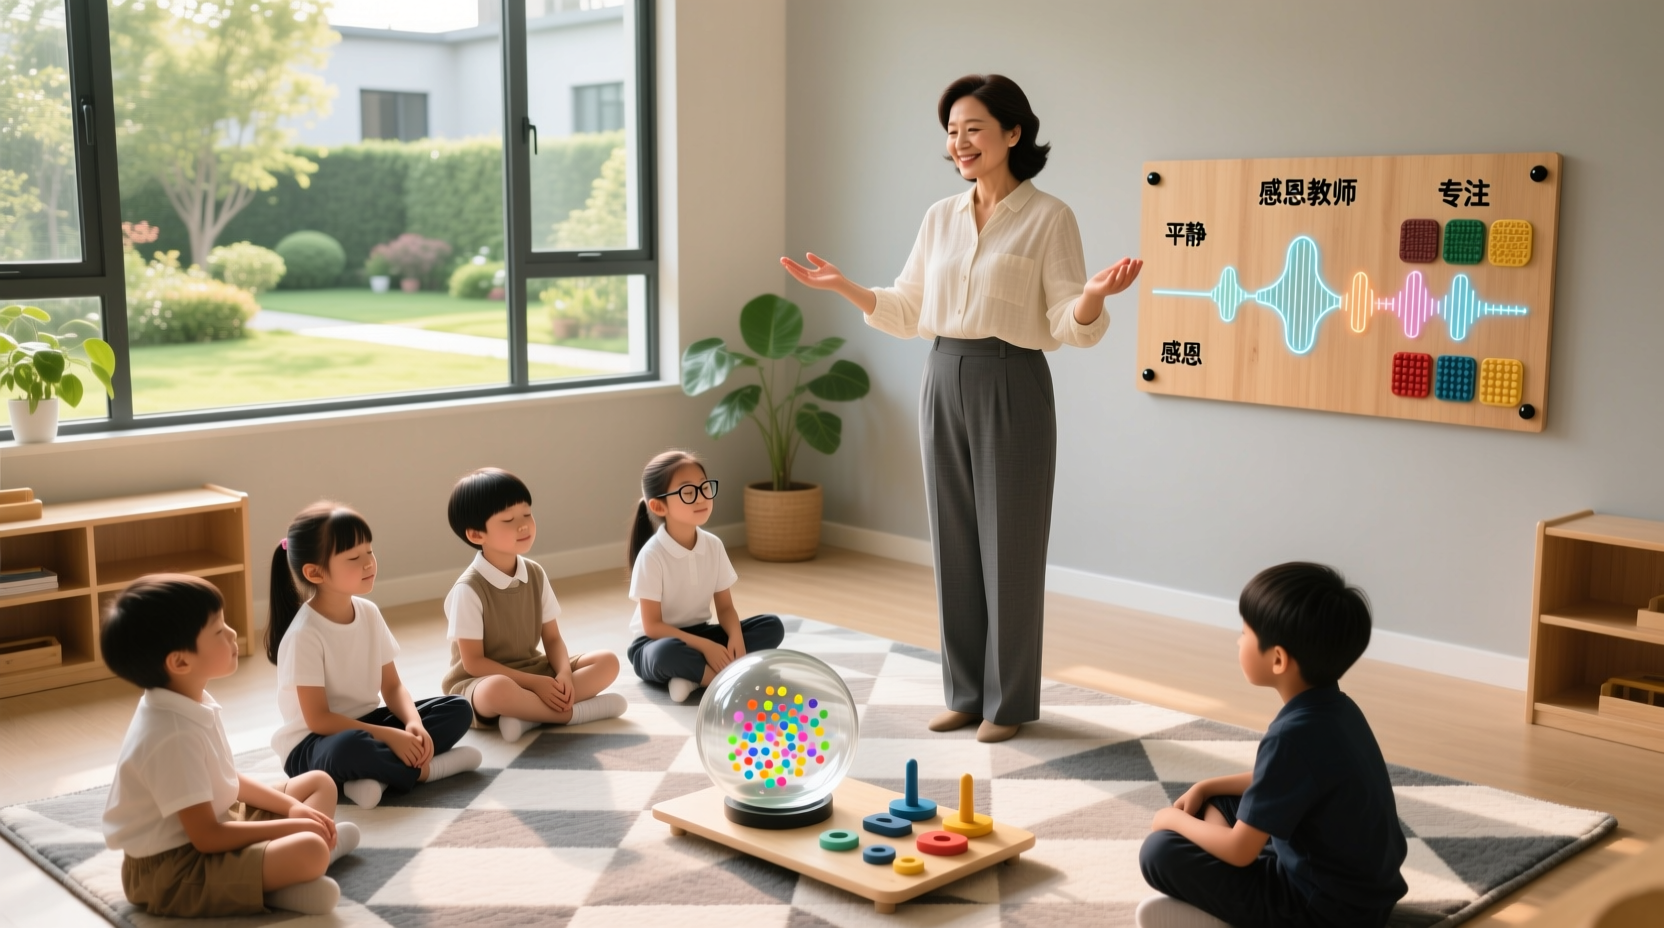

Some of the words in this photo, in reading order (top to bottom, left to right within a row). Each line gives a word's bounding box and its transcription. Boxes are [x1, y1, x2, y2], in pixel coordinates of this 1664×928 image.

[1259, 178, 1358, 207] 感恩教师
[1438, 179, 1491, 208] 专注
[1165, 221, 1207, 247] 平静
[1160, 340, 1203, 366] 感恩
